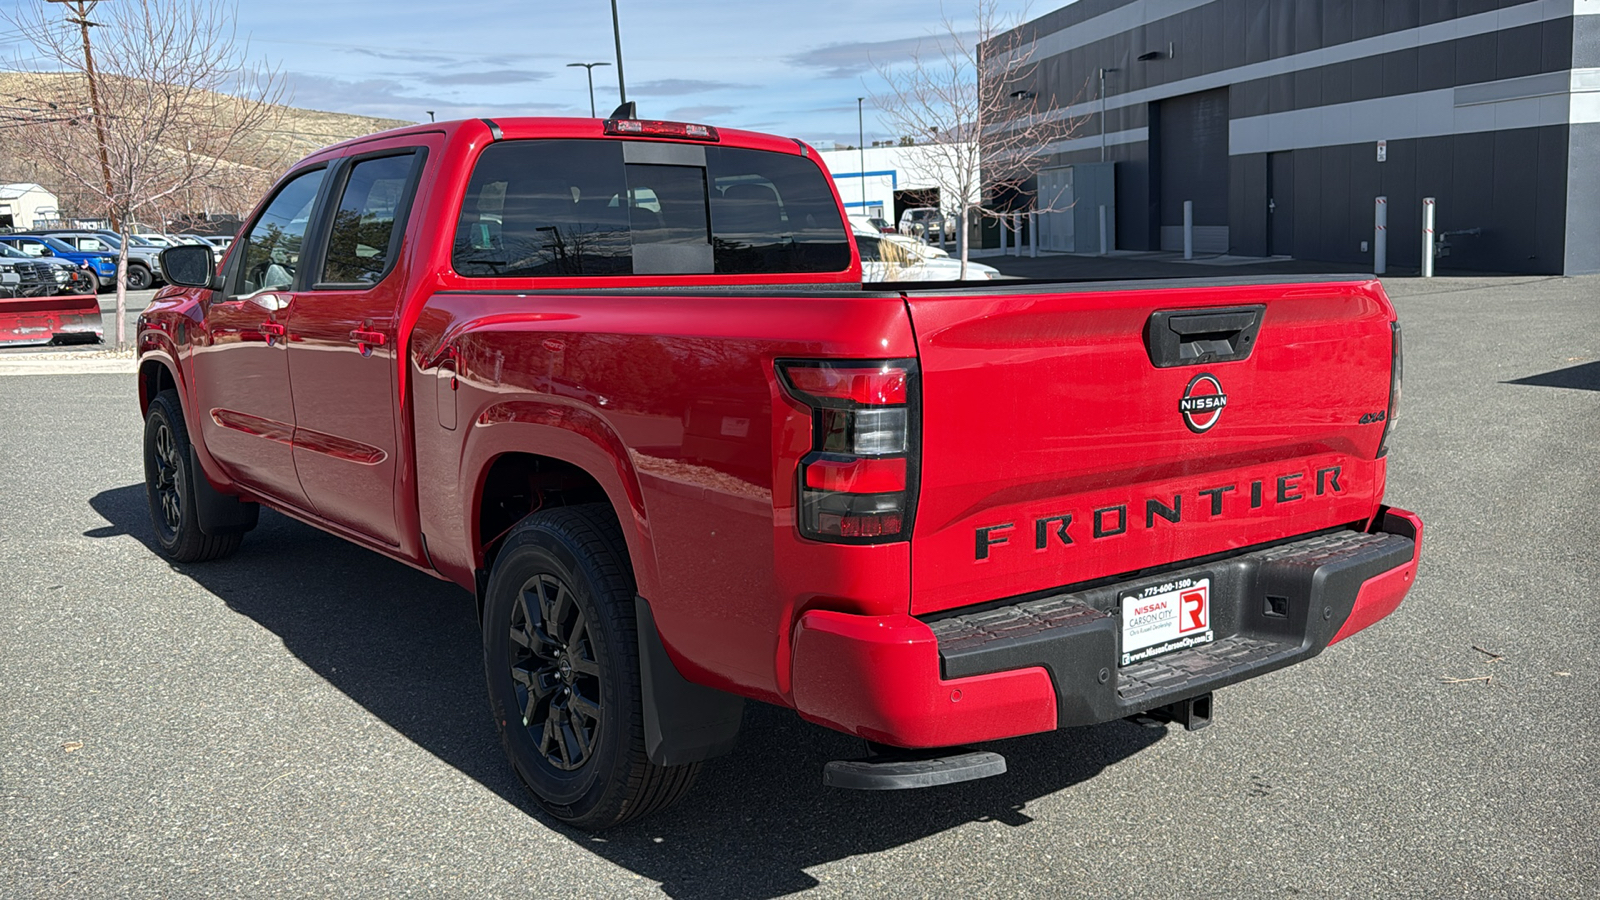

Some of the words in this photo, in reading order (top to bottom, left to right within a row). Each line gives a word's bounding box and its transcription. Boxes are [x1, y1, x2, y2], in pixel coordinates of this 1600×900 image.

[1181, 396, 1227, 411] NISSAN
[974, 466, 1342, 561] FRONTIER
[1144, 578, 1191, 597] 775-600-1500
[1130, 614, 1158, 627] CARSON
[1159, 609, 1173, 621] CITY
[1134, 602, 1167, 616] NISSAN
[1130, 635, 1205, 661] www.NissanCarsonCity.com
